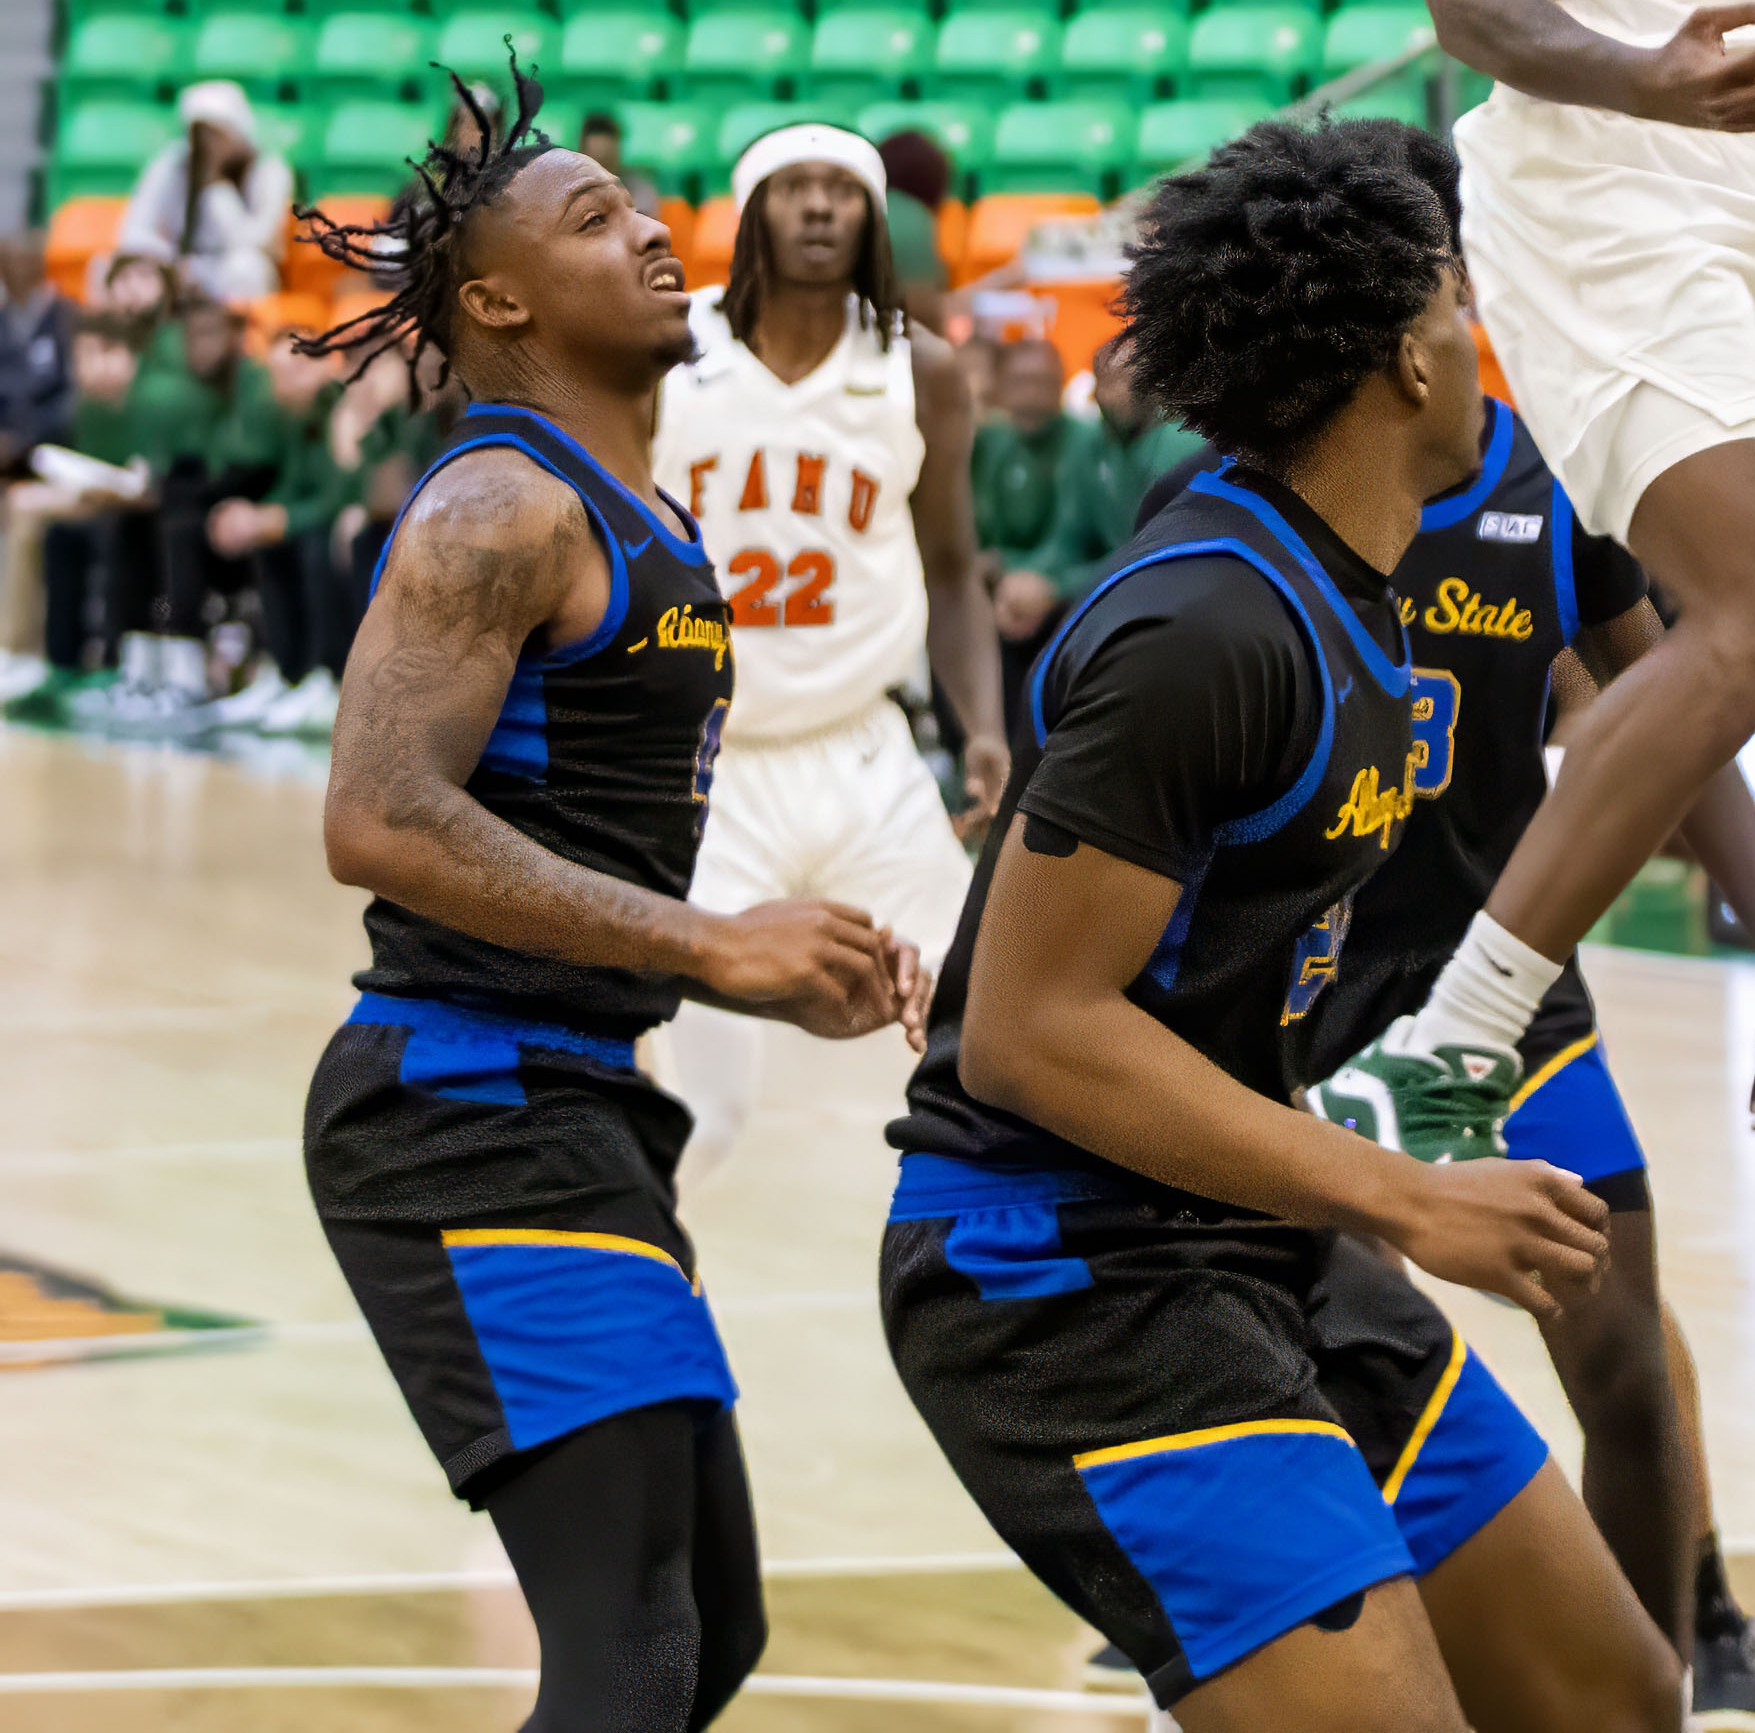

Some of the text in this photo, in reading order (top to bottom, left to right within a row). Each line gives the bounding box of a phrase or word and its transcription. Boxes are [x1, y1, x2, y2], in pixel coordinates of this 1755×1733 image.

[689, 445, 882, 535] FAMU
[728, 541, 837, 627] 22
[1423, 576, 1534, 642] State
